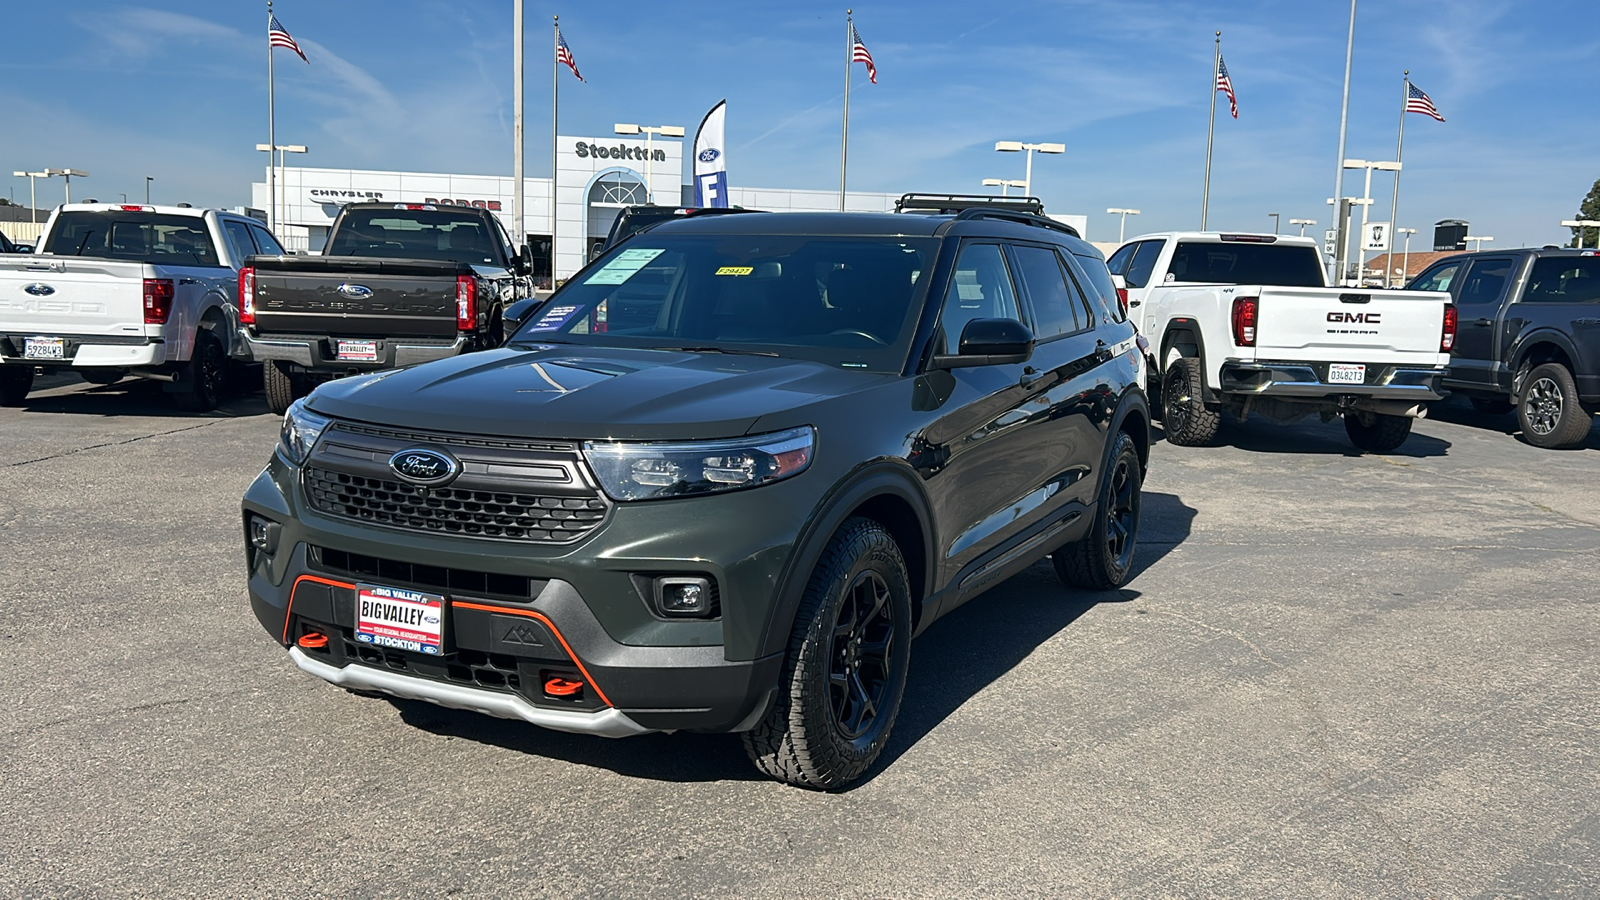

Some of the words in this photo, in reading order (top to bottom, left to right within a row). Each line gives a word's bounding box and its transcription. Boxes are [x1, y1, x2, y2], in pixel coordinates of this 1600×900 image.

[575, 141, 666, 162] Stockton
[310, 189, 384, 199] CHRYSLER
[425, 197, 502, 211] DODGE
[267, 300, 364, 310] SUPER
[371, 302, 446, 313] DUTY
[1327, 312, 1381, 323] GMC
[1331, 371, 1363, 381] 03482T3
[402, 455, 439, 476] Ford
[376, 588, 391, 597] BIG
[393, 591, 422, 602] VALLEY
[362, 601, 424, 626] BIGVALLEY
[374, 635, 421, 651] STOCKTON
